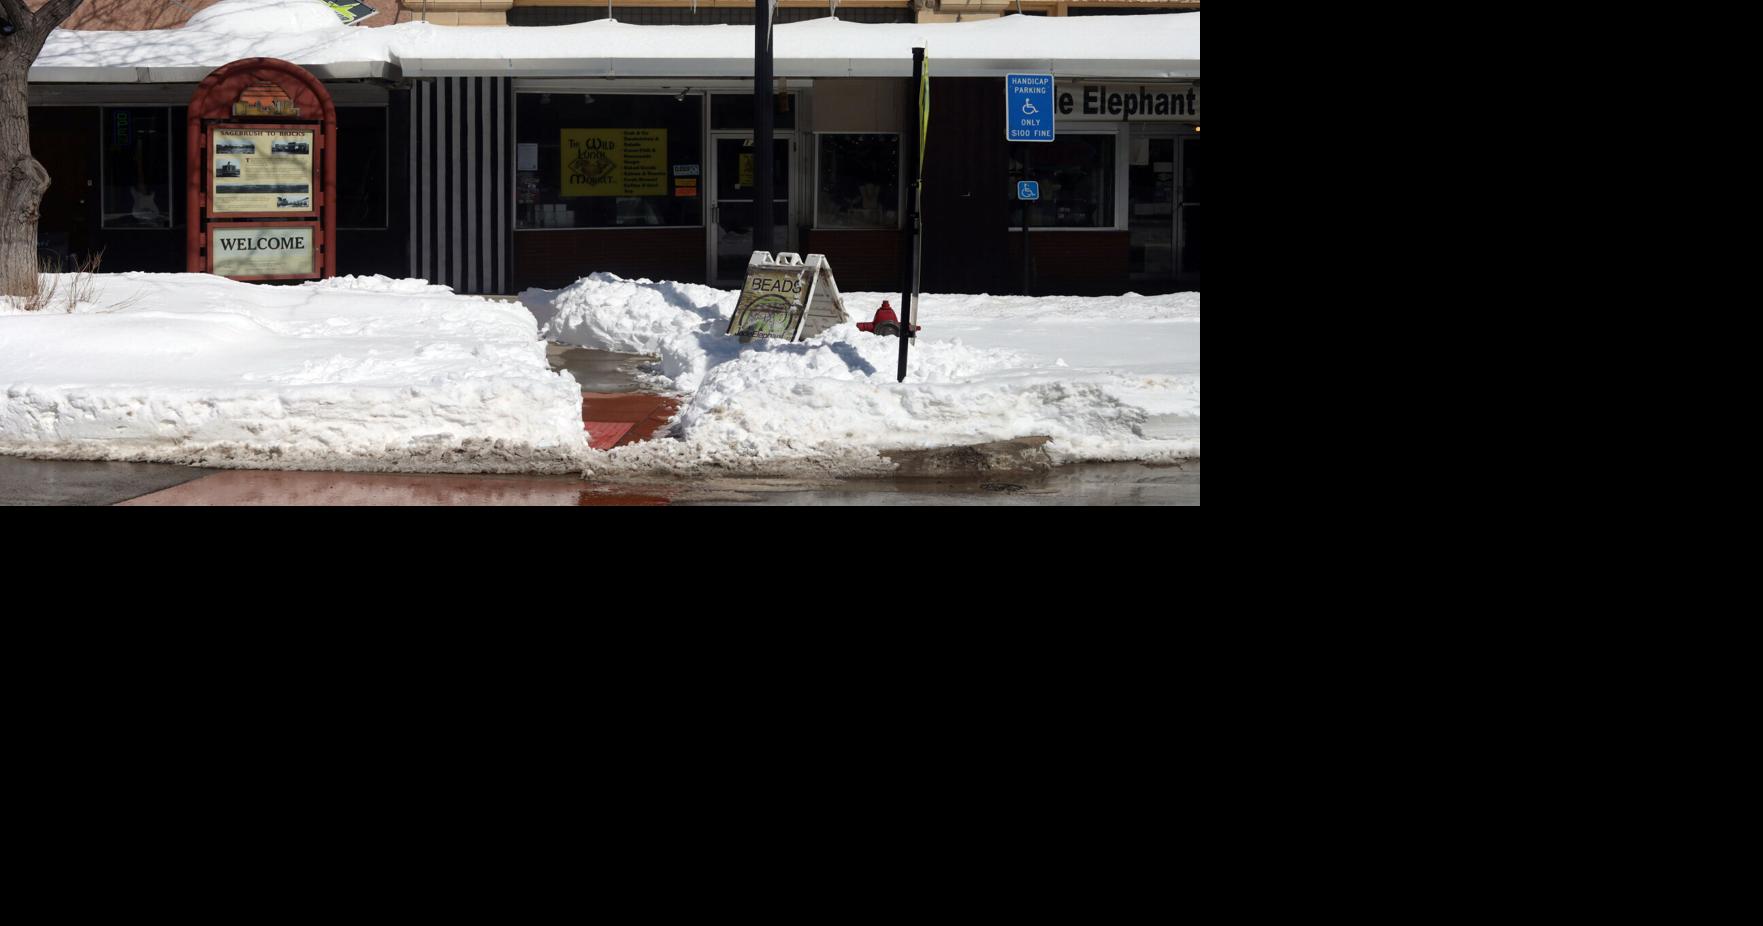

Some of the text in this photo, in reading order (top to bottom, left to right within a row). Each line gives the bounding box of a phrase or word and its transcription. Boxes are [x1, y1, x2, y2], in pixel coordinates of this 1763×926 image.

[1012, 77, 1049, 85] HANDICAP
[1014, 86, 1046, 94] PARKING
[1083, 85, 1196, 122] Elephant
[266, 129, 276, 137] TO
[1034, 129, 1051, 137] FINE
[220, 237, 305, 251] WELCOME
[751, 278, 802, 294] BEADS
